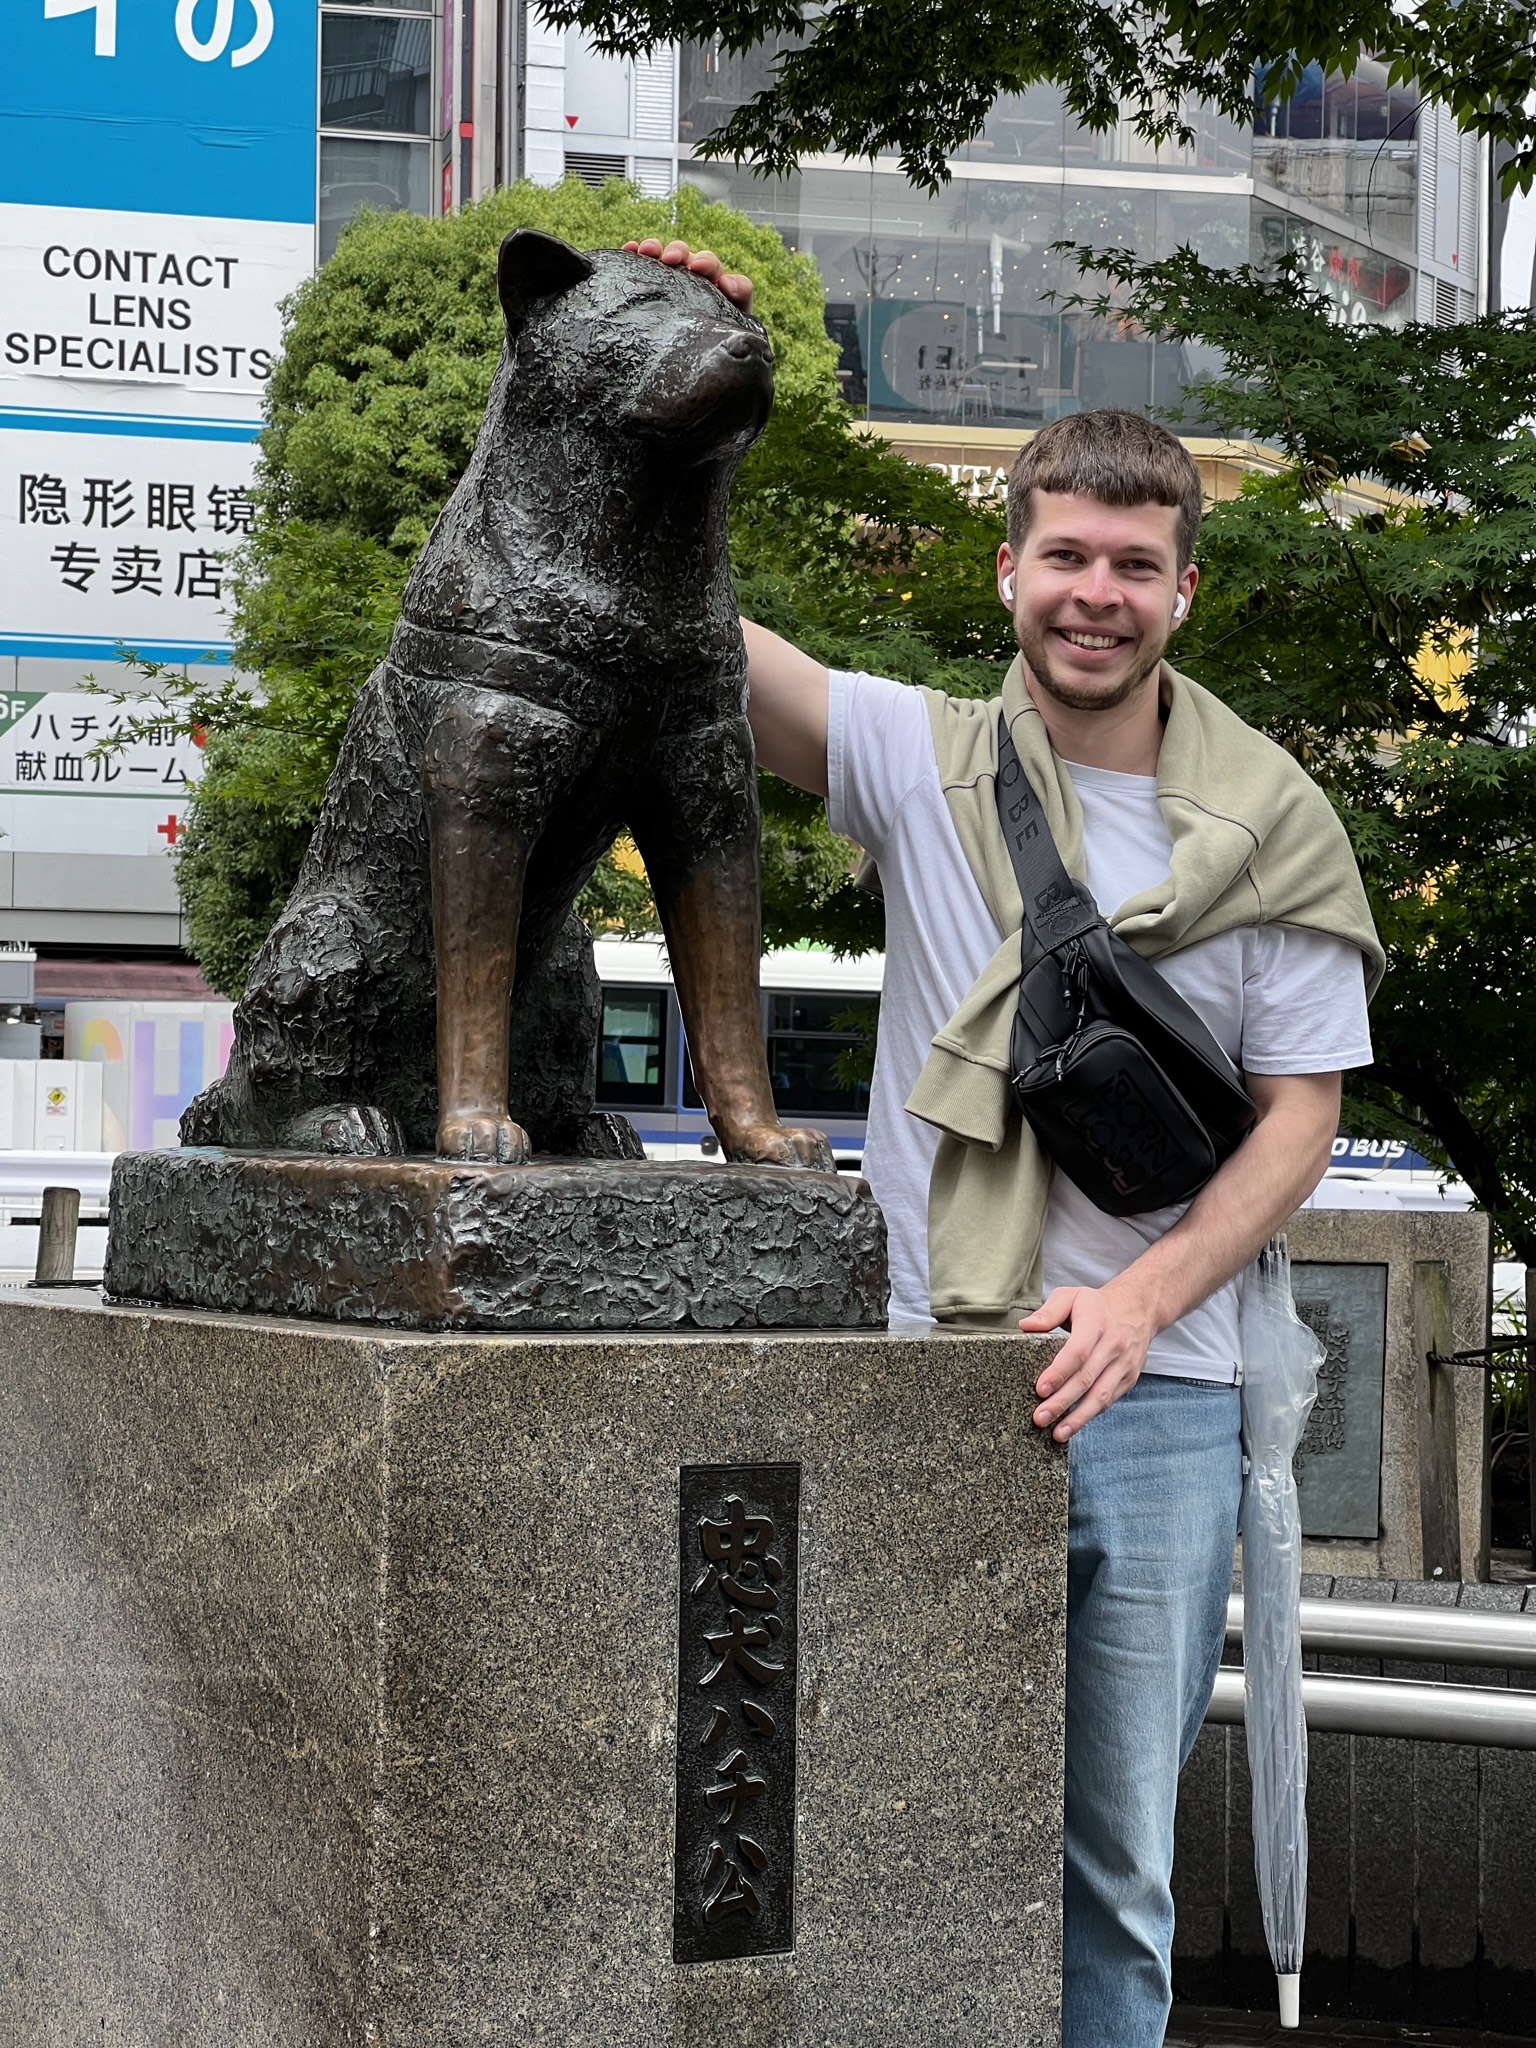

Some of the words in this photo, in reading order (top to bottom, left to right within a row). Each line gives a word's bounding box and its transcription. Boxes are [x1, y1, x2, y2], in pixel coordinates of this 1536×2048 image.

[43, 246, 239, 289] CONTACT
[89, 293, 192, 330] LENS
[5, 332, 273, 380] SPECIALISTS
[19, 473, 256, 535] 隐形眼镜
[51, 541, 224, 600] 专卖店
[15, 750, 188, 783] 献血ルーム
[1008, 792, 1039, 852] BE
[1350, 1139, 1407, 1158] BUS
[690, 1494, 785, 1923] 忠犬ハチ公
